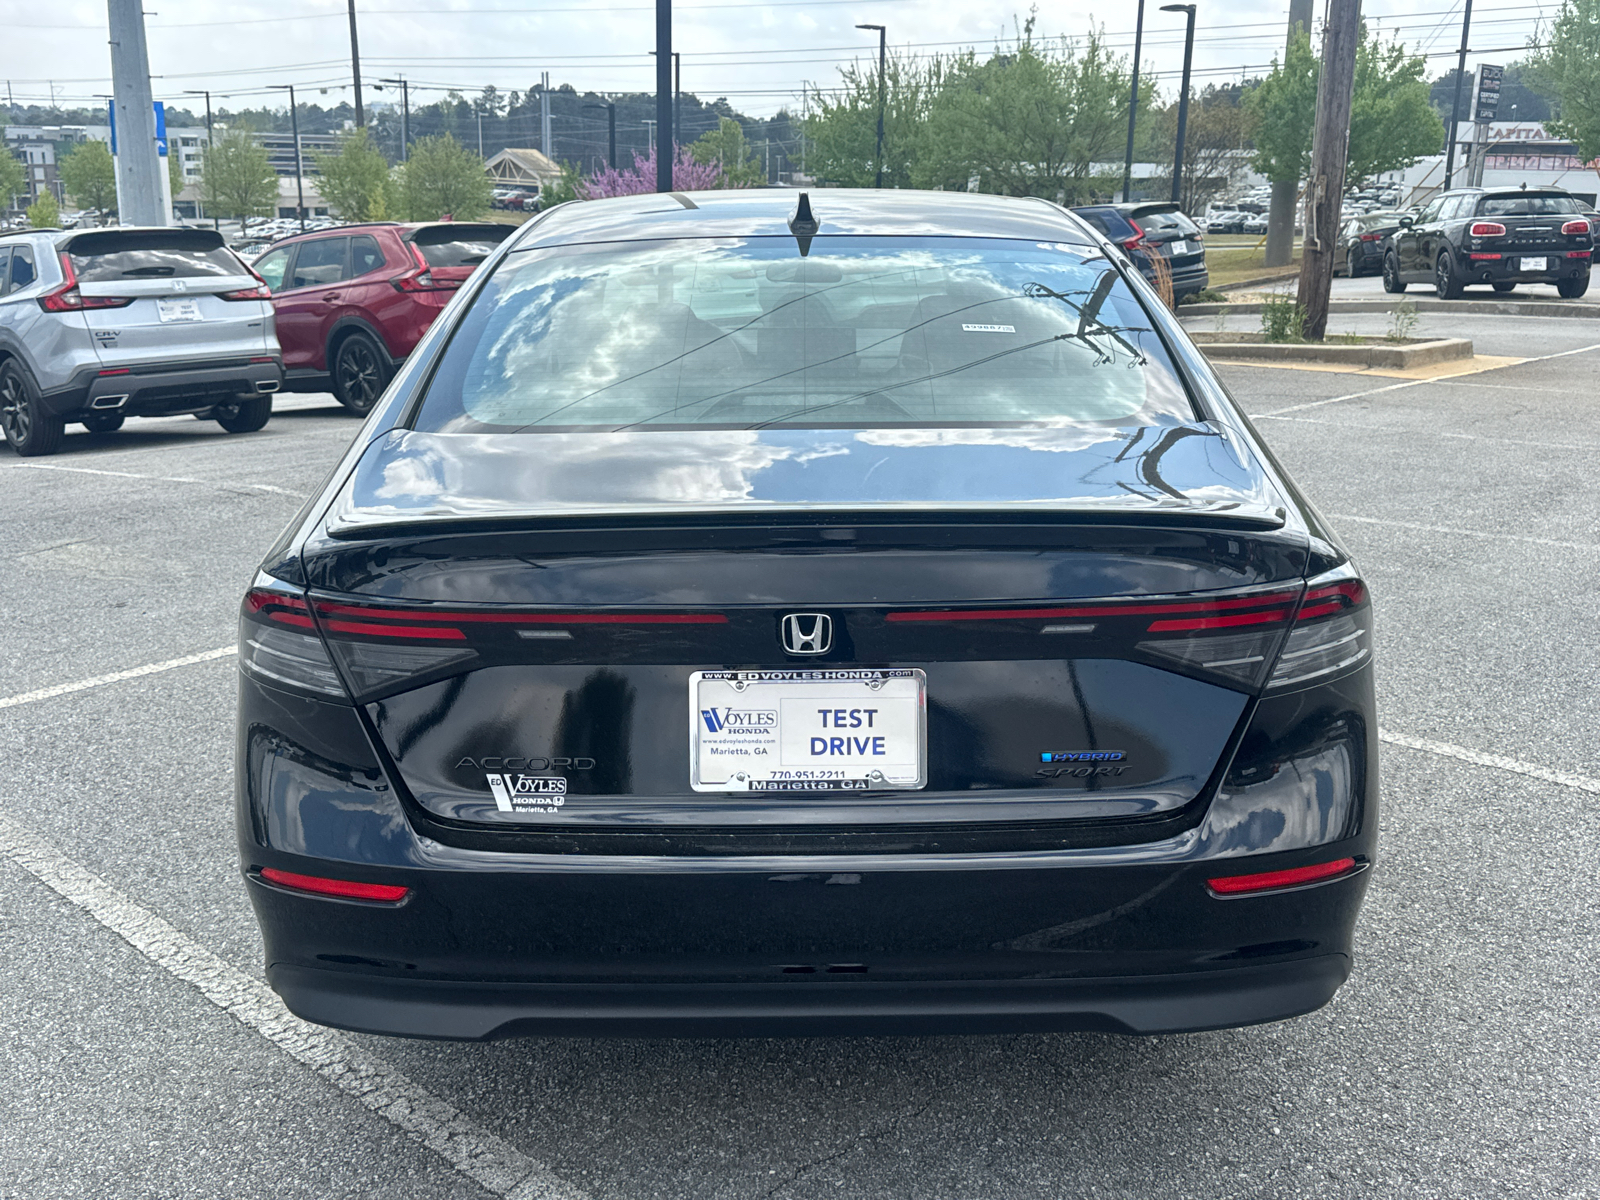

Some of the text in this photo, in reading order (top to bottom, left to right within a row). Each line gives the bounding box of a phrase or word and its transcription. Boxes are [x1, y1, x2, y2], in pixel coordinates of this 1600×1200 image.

[817, 709, 878, 728] TEST
[710, 747, 768, 756] Marietta, GA
[810, 737, 886, 756] DRIVE
[1053, 752, 1122, 762] HYBRID
[454, 756, 596, 771] ACCORD
[770, 771, 846, 779] 770-951-2211
[1033, 765, 1133, 779] SPORT
[490, 778, 502, 786] ED
[751, 780, 867, 790] Marietta, GA
[512, 797, 553, 805] HONDA
